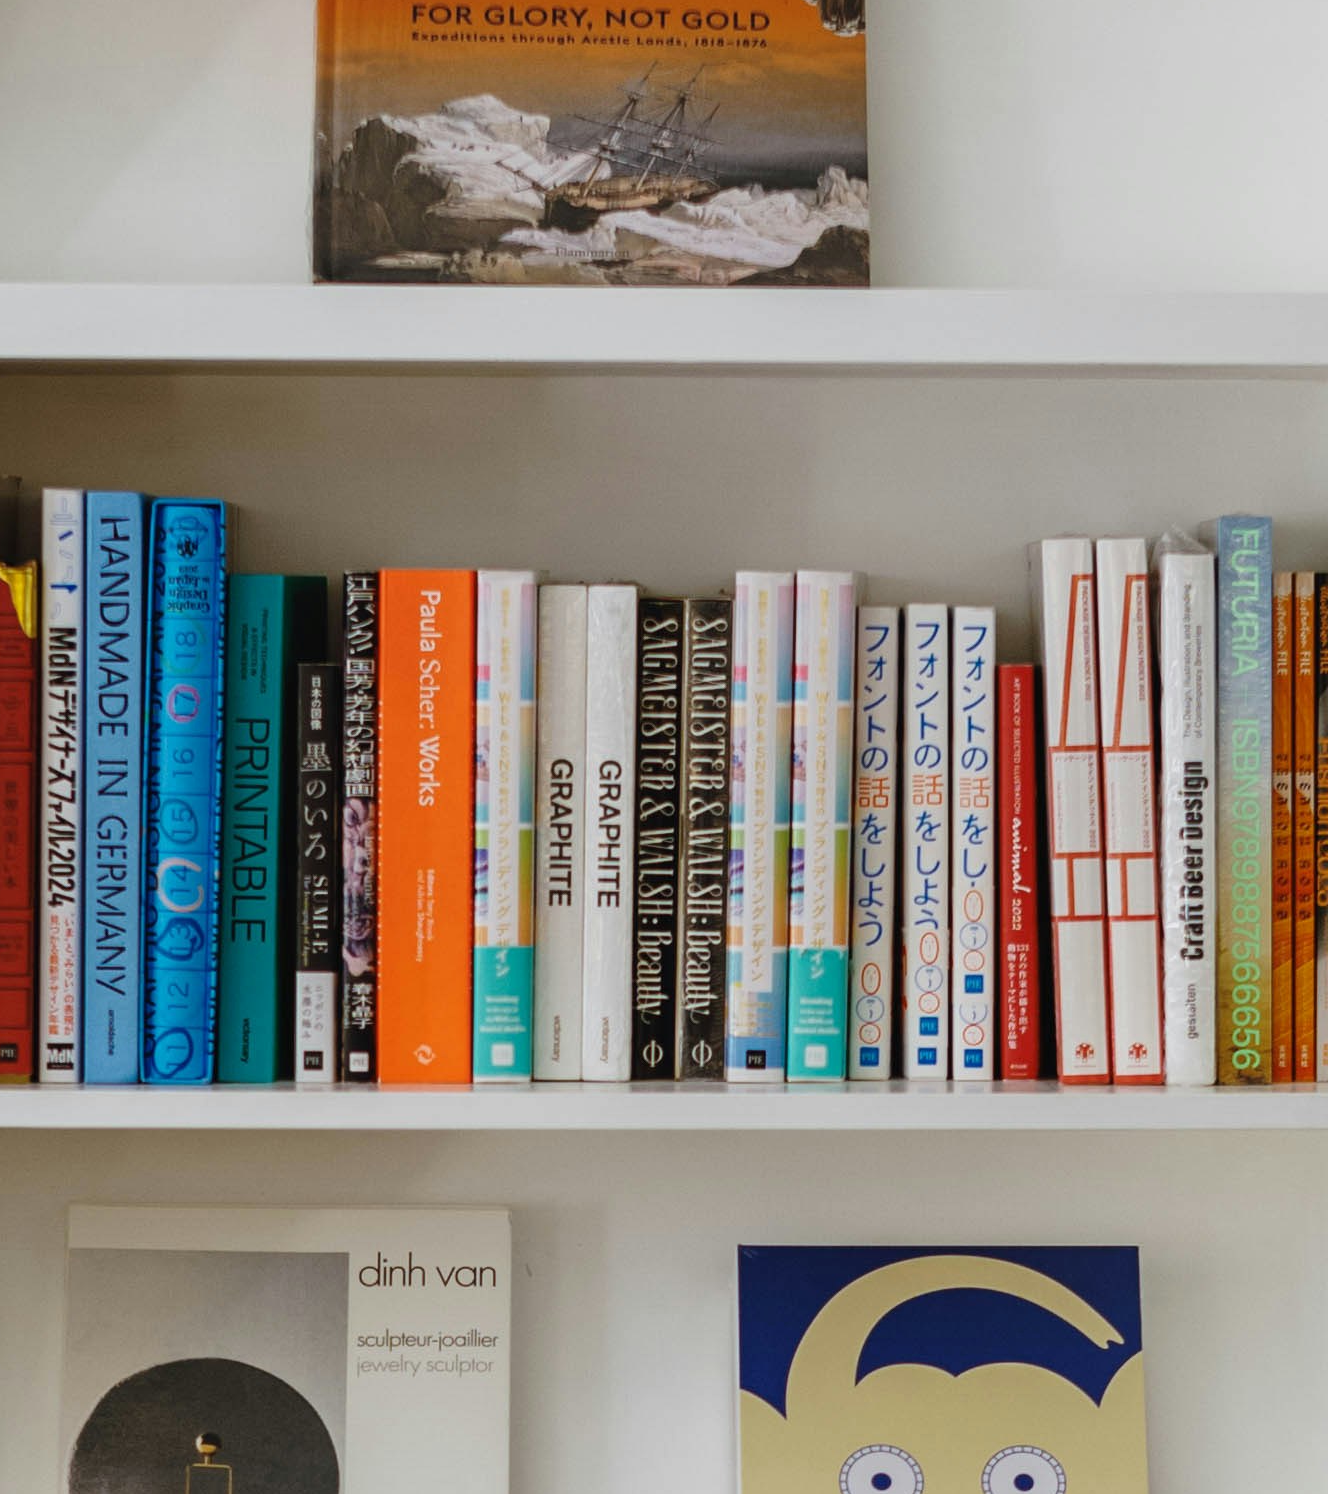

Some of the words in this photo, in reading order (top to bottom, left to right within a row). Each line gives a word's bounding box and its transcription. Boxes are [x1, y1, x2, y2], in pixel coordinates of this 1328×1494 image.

[412, 5, 470, 25] FOR
[484, 8, 594, 31] GLORY,
[606, 9, 667, 29] NOT
[681, 11, 770, 31] GOLD
[412, 32, 505, 45] Expeditions
[512, 34, 575, 47] through
[582, 35, 631, 45] Arctic
[99, 516, 129, 738] HANDMADE
[420, 590, 441, 652] Paula
[420, 659, 441, 729] Scher:
[99, 759, 127, 798] IN
[419, 736, 440, 807] Works
[859, 626, 889, 947] フォントの話をしよう
[1183, 761, 1208, 837] Design
[231, 717, 269, 943] PRINTABLE
[548, 759, 572, 906] GRAPHITE
[1182, 842, 1204, 899] Beer
[97, 814, 126, 997] GERMANY
[1181, 905, 1204, 961] Craft
[358, 1252, 425, 1287] dinh
[436, 1264, 496, 1287] van
[356, 1330, 498, 1350] sculpteur-joaillier
